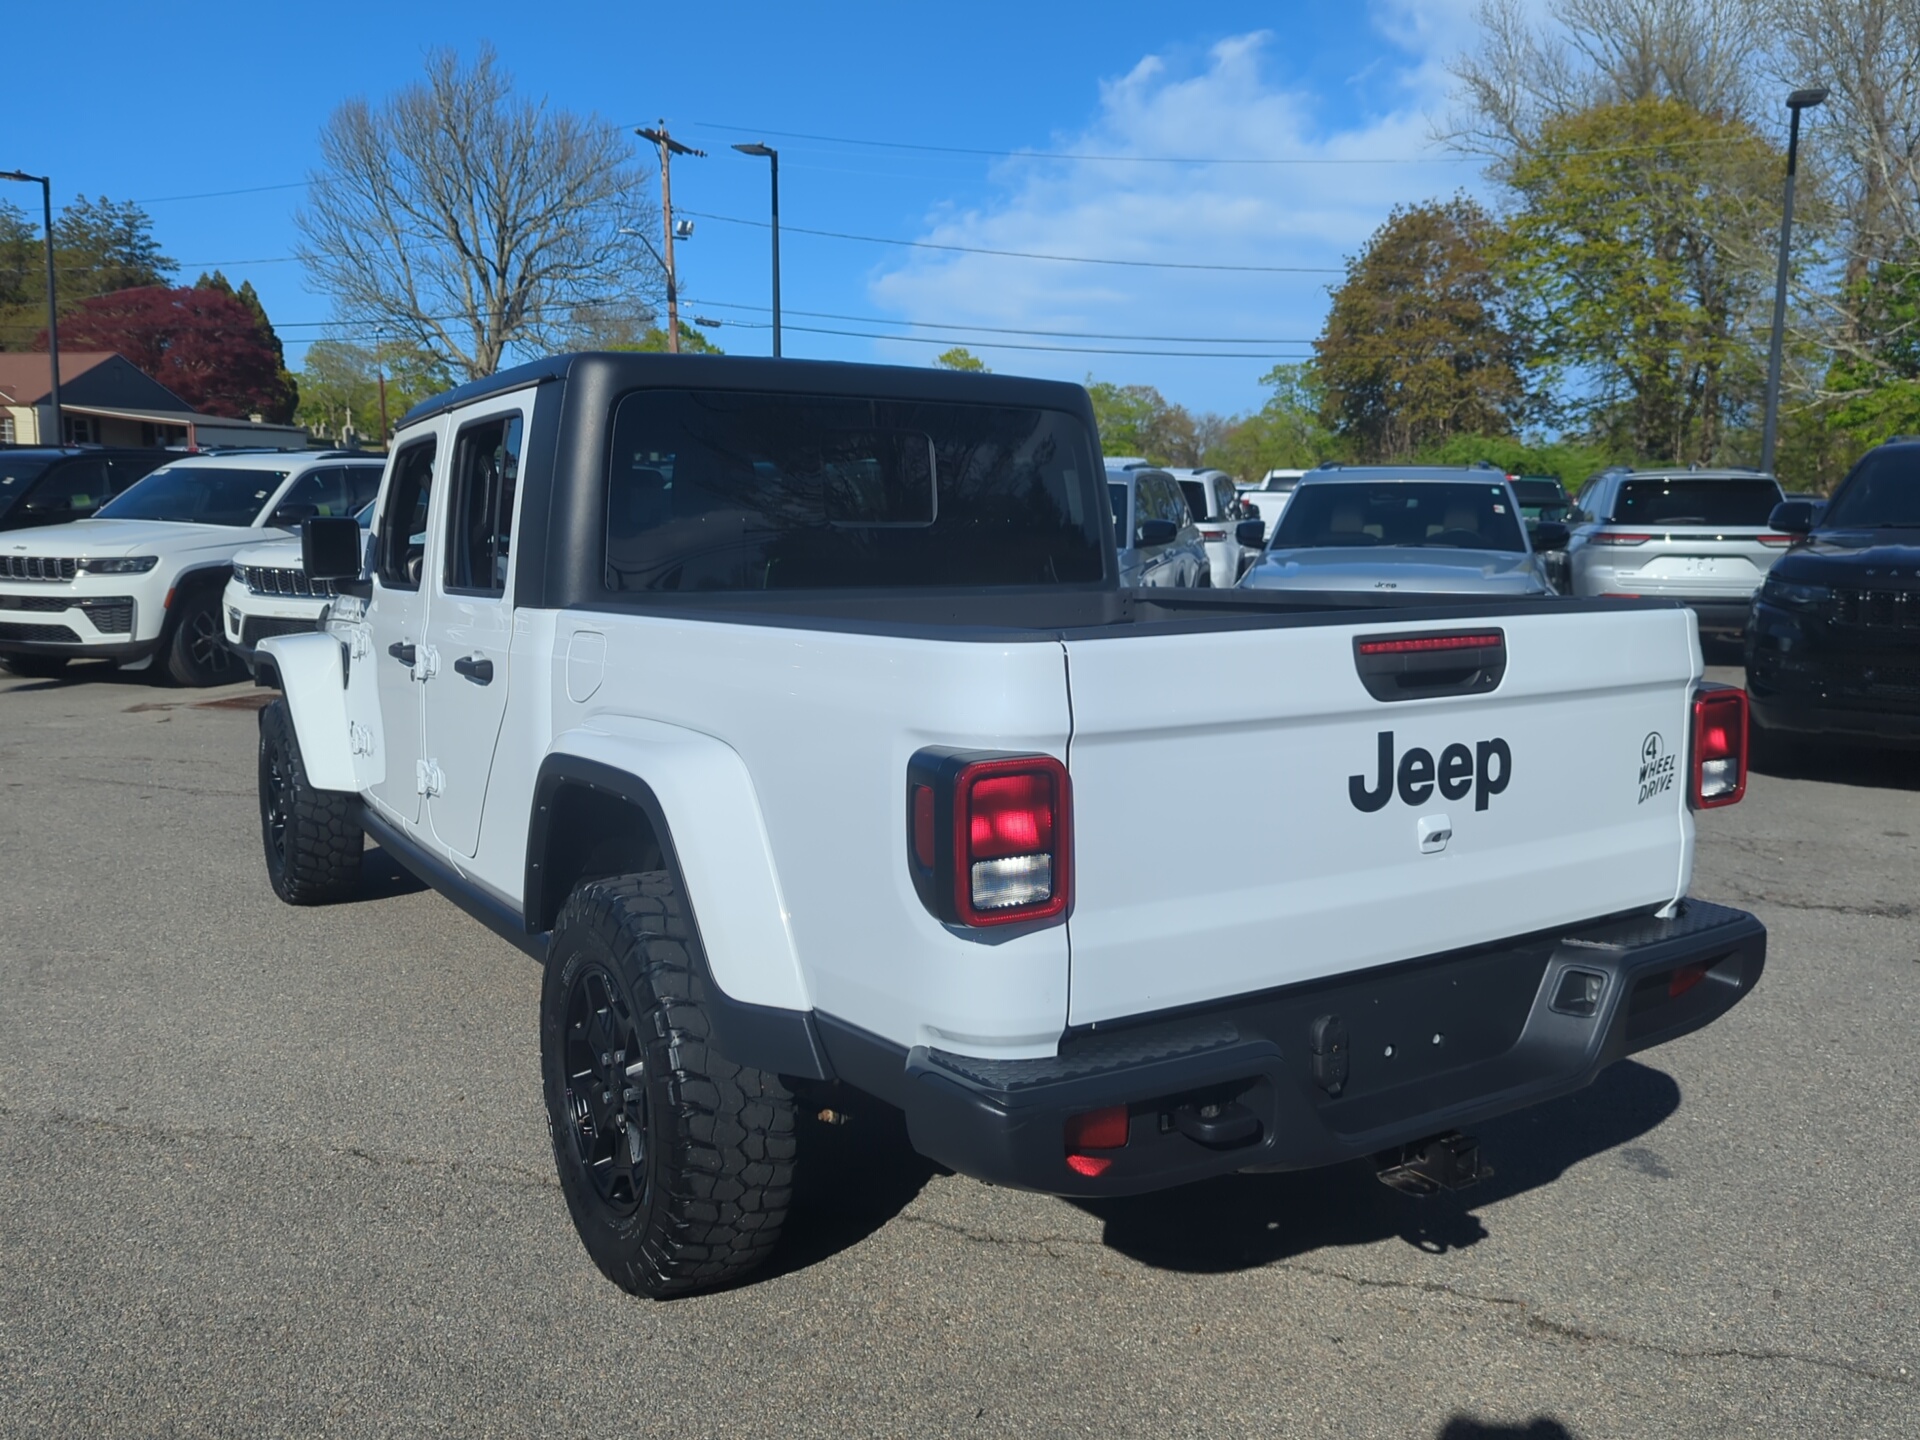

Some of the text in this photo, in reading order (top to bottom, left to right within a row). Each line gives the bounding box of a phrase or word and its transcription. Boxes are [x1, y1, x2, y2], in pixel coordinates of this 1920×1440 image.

[1348, 731, 1512, 813] Jeep
[1638, 754, 1676, 785] WHEEL
[1637, 773, 1674, 805] DRIVE
